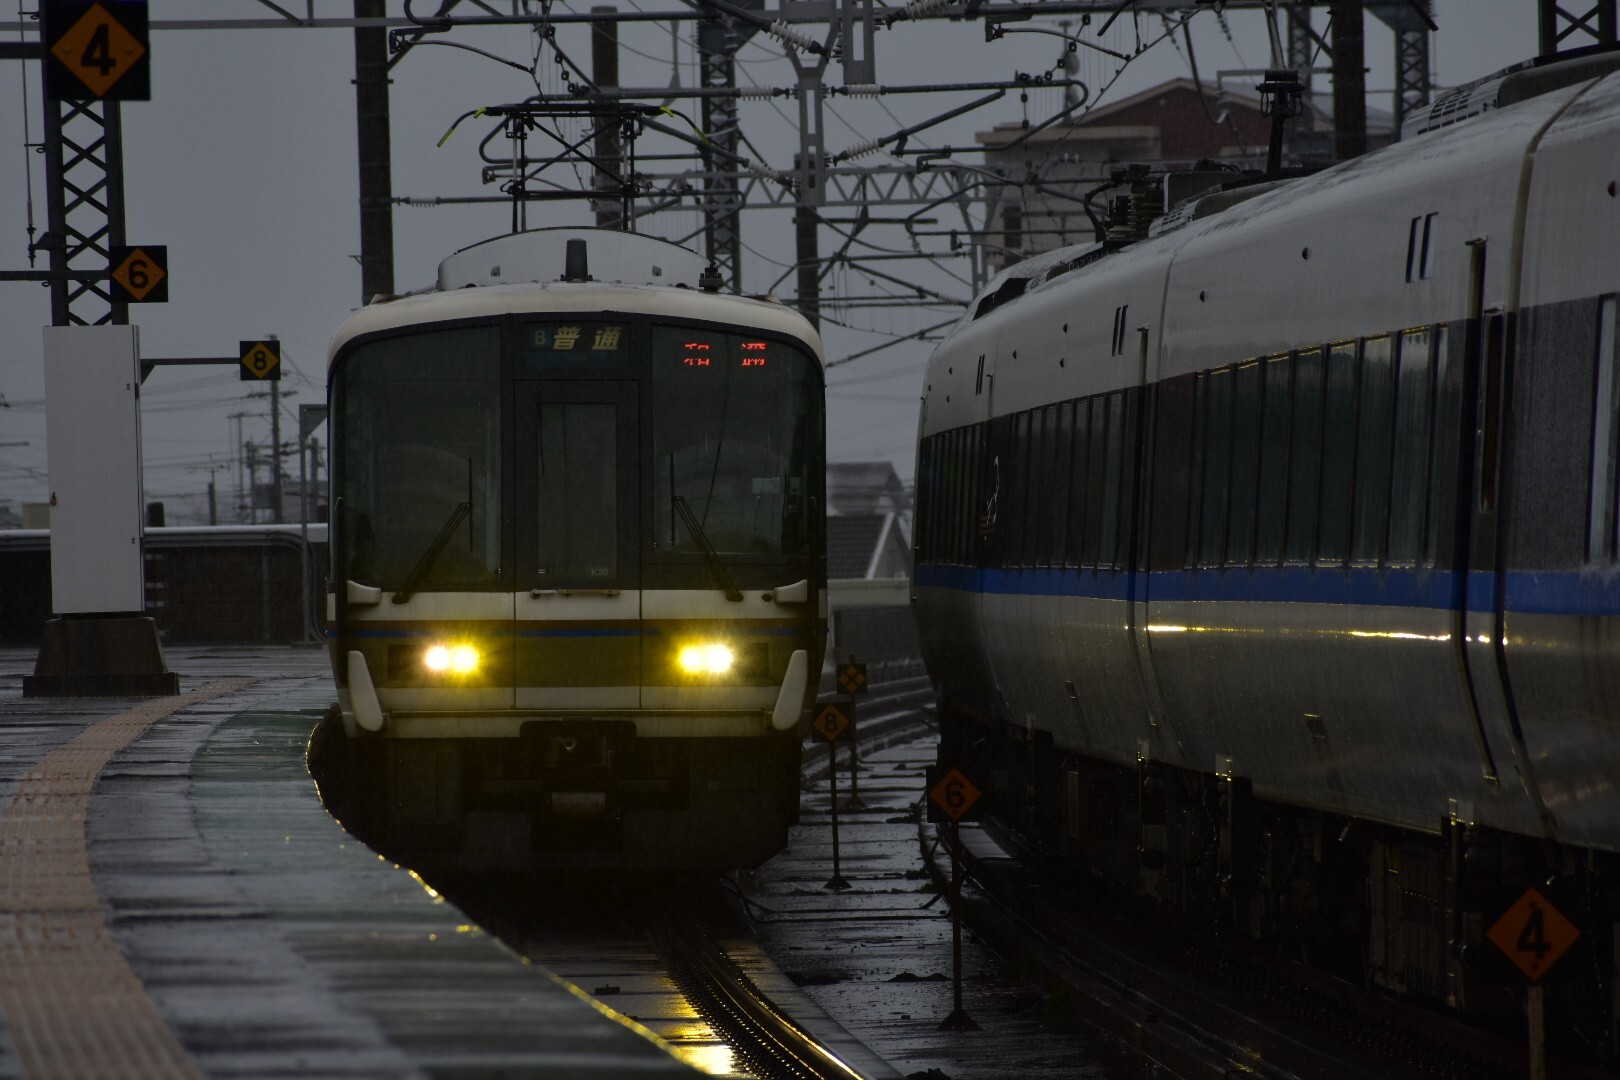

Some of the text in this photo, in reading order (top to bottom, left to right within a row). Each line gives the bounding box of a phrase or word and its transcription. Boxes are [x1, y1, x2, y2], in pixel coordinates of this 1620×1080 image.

[82, 24, 117, 76] 4
[129, 260, 148, 289] 6
[534, 326, 623, 351] B 普通
[253, 350, 267, 371] 8
[825, 713, 837, 732] 8
[945, 780, 965, 807] 6
[1516, 908, 1552, 958] 4
